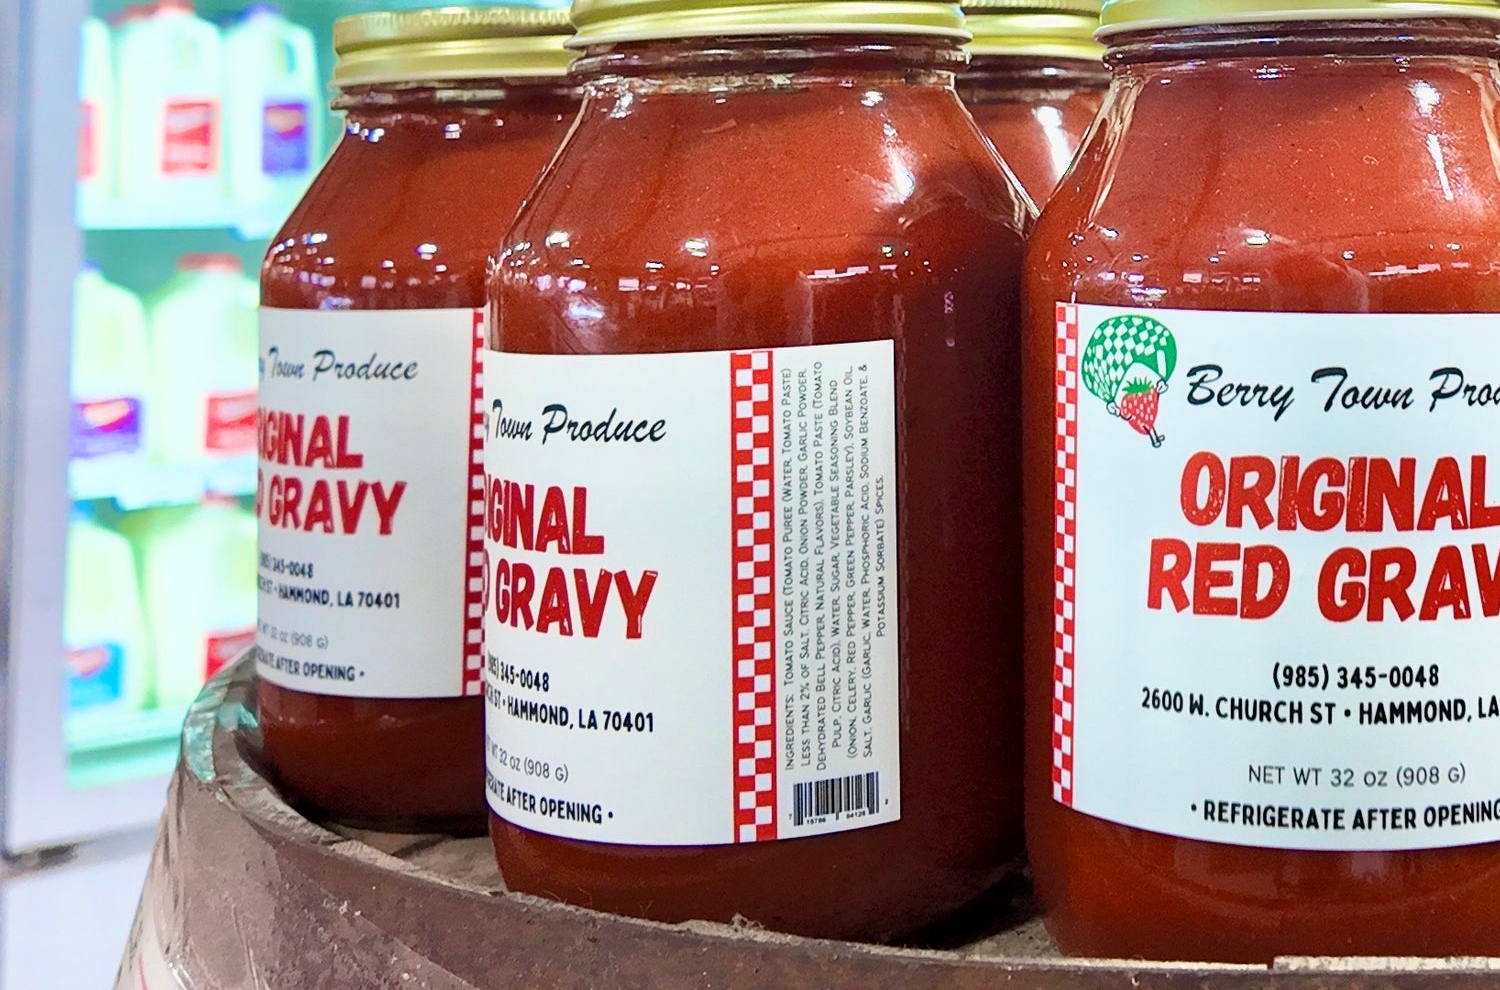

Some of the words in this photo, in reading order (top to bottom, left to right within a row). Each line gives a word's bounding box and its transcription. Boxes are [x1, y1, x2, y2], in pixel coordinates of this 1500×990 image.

[312, 349, 419, 382] Produce
[1186, 363, 1296, 422] Berry
[1311, 366, 1415, 413] Town
[492, 398, 533, 441] Town
[542, 403, 667, 445] Produce
[269, 474, 408, 536] GRAVY
[1146, 537, 1291, 620] RED
[337, 590, 354, 608] LA
[358, 591, 400, 609] 70401
[495, 558, 659, 640] GRAVY
[303, 662, 355, 682] OPENING
[500, 660, 550, 692] 345-0048
[1272, 662, 1329, 691] (985)
[1336, 664, 1440, 690] 345-0048
[507, 695, 574, 730] HAMMOND,
[579, 708, 598, 730] LA
[603, 710, 654, 732] 70401
[1141, 687, 1184, 714] 2600
[1189, 694, 1209, 717] W.
[1215, 696, 1303, 724] CHURCH
[1310, 702, 1336, 725] ST
[1359, 697, 1473, 726] HAMMOND,
[1477, 694, 1500, 718] LA
[523, 756, 550, 779] (908
[1248, 764, 1285, 786] NET
[1293, 767, 1322, 787] WT
[1330, 769, 1354, 788] 32
[1395, 765, 1440, 789] (908
[506, 785, 537, 815] AFTER
[540, 795, 603, 824] OPENING
[1203, 800, 1346, 830] REFRIGERATE
[1352, 806, 1417, 831] AFTER
